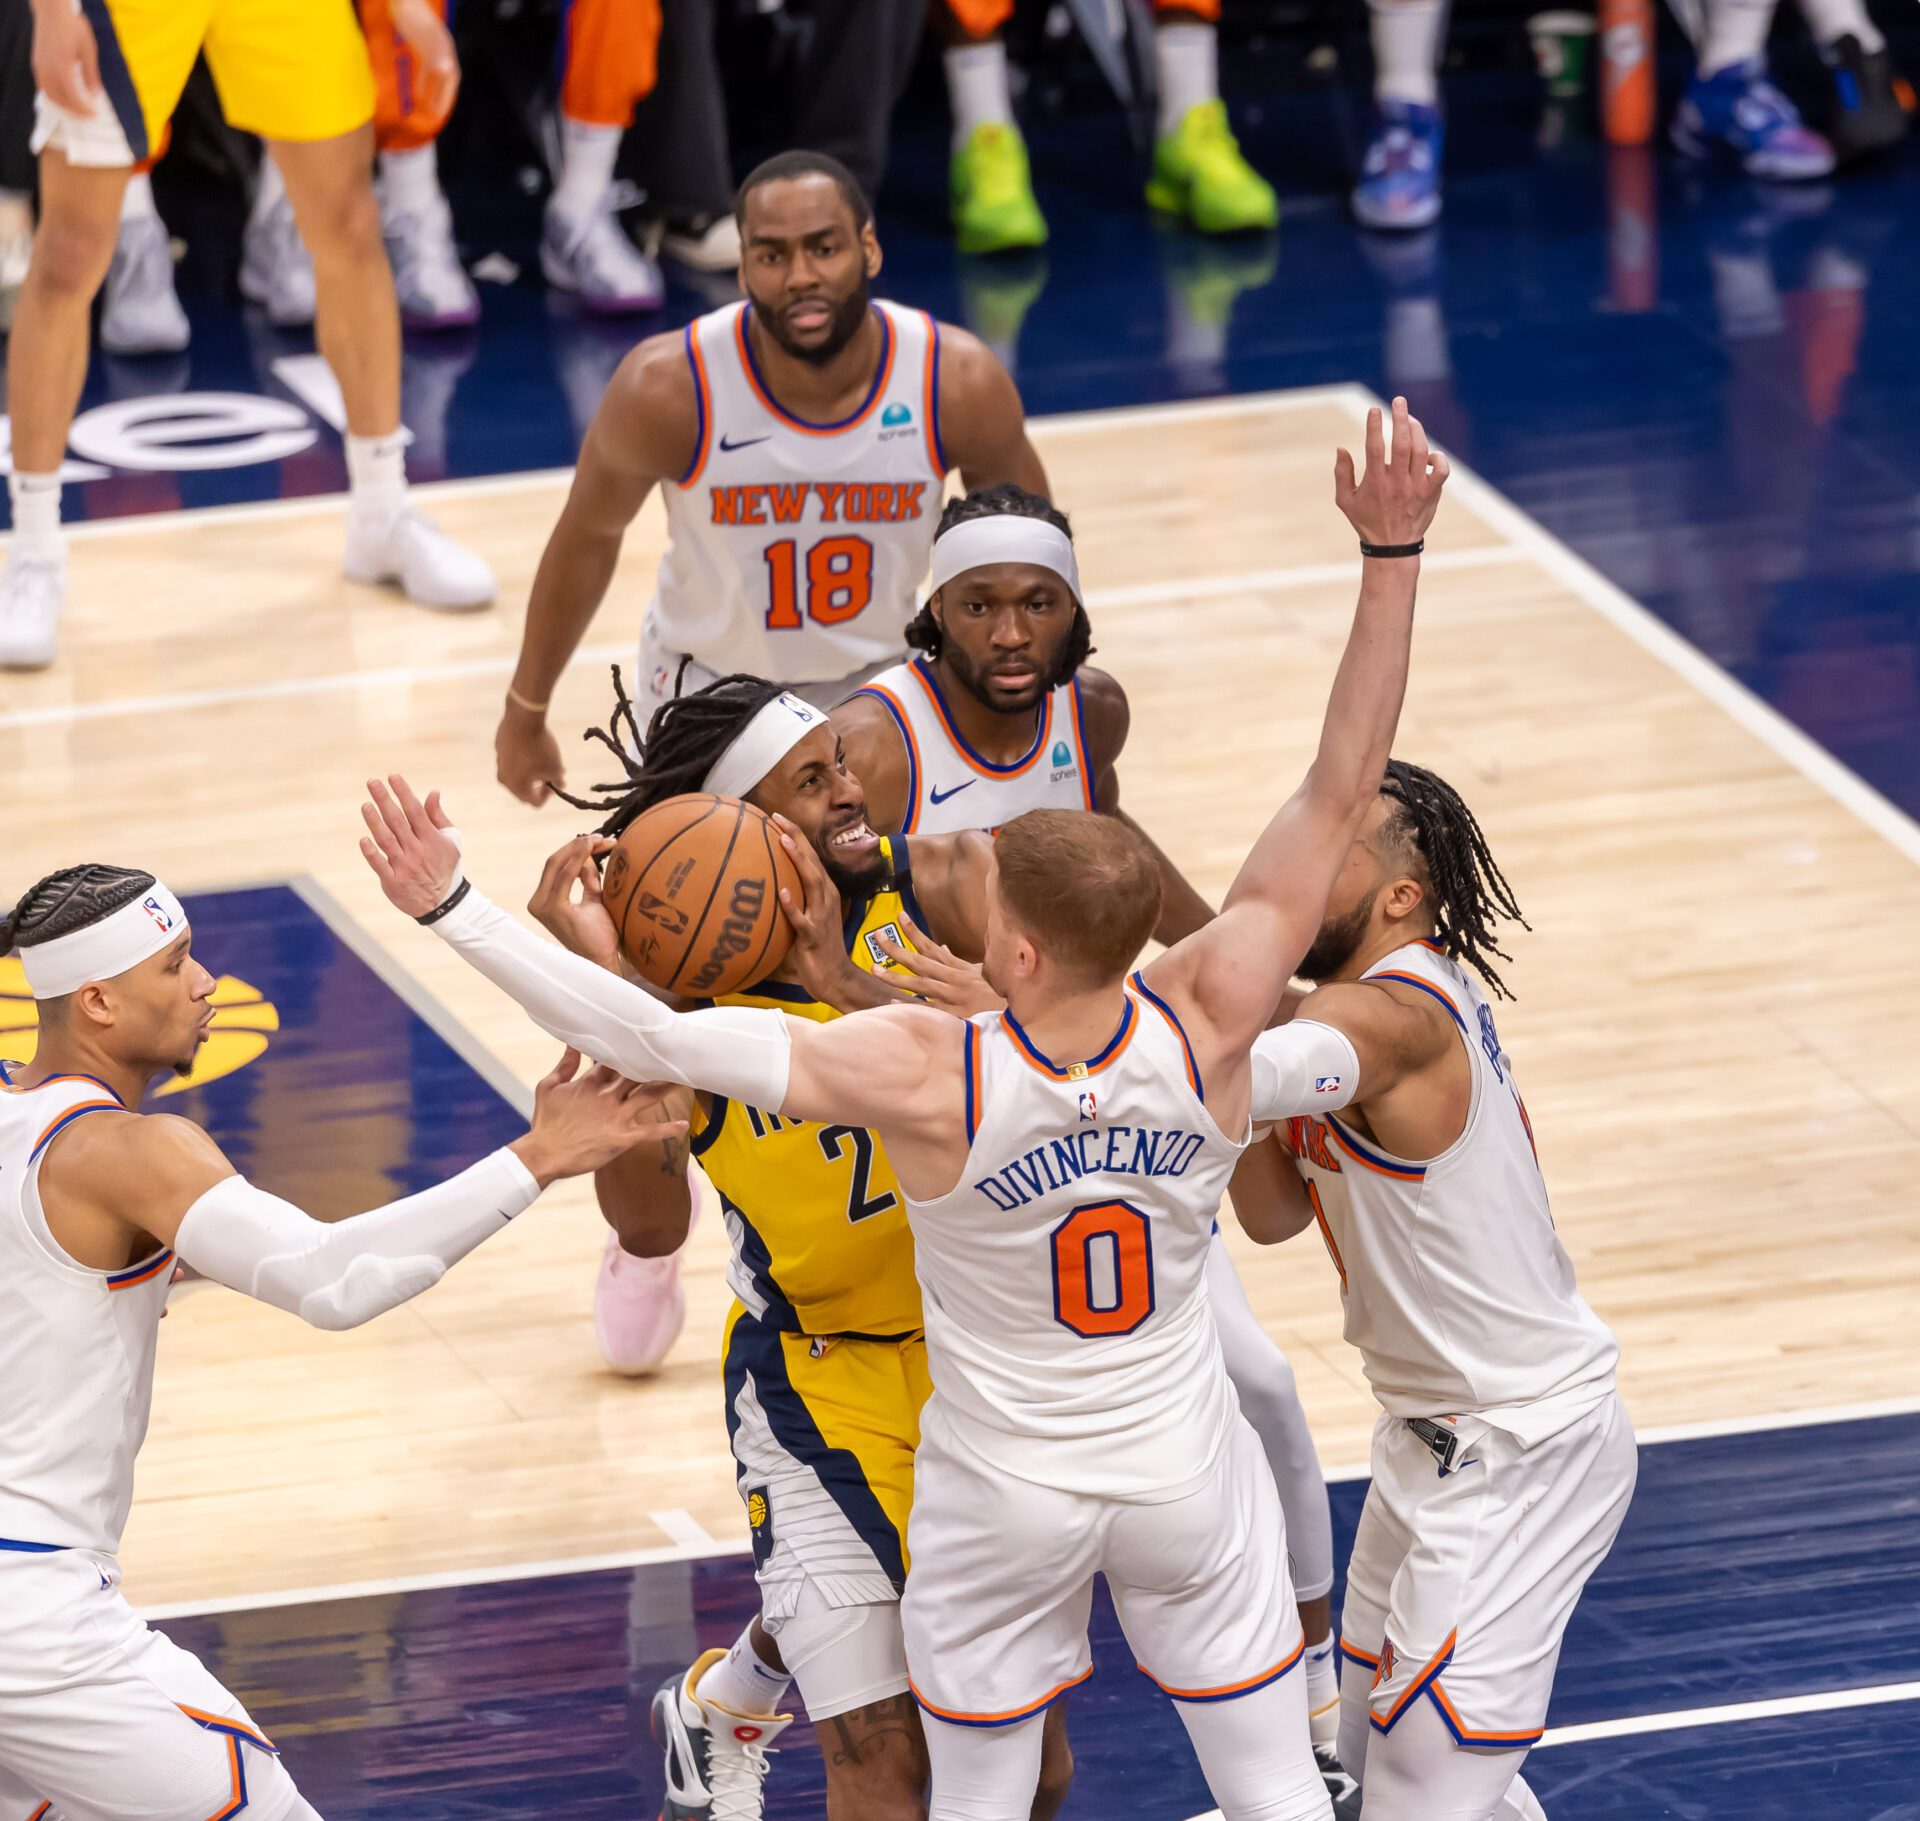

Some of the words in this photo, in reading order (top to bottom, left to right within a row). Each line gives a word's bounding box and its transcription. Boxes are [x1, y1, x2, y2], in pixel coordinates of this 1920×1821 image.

[710, 483, 809, 525] NEW
[814, 480, 926, 523] YORK
[764, 534, 873, 630] 18
[1050, 768, 1077, 783] sphere
[688, 878, 766, 990] Wilson
[974, 1126, 1205, 1211] DIVINCENZO
[1050, 1198, 1155, 1339] 0
